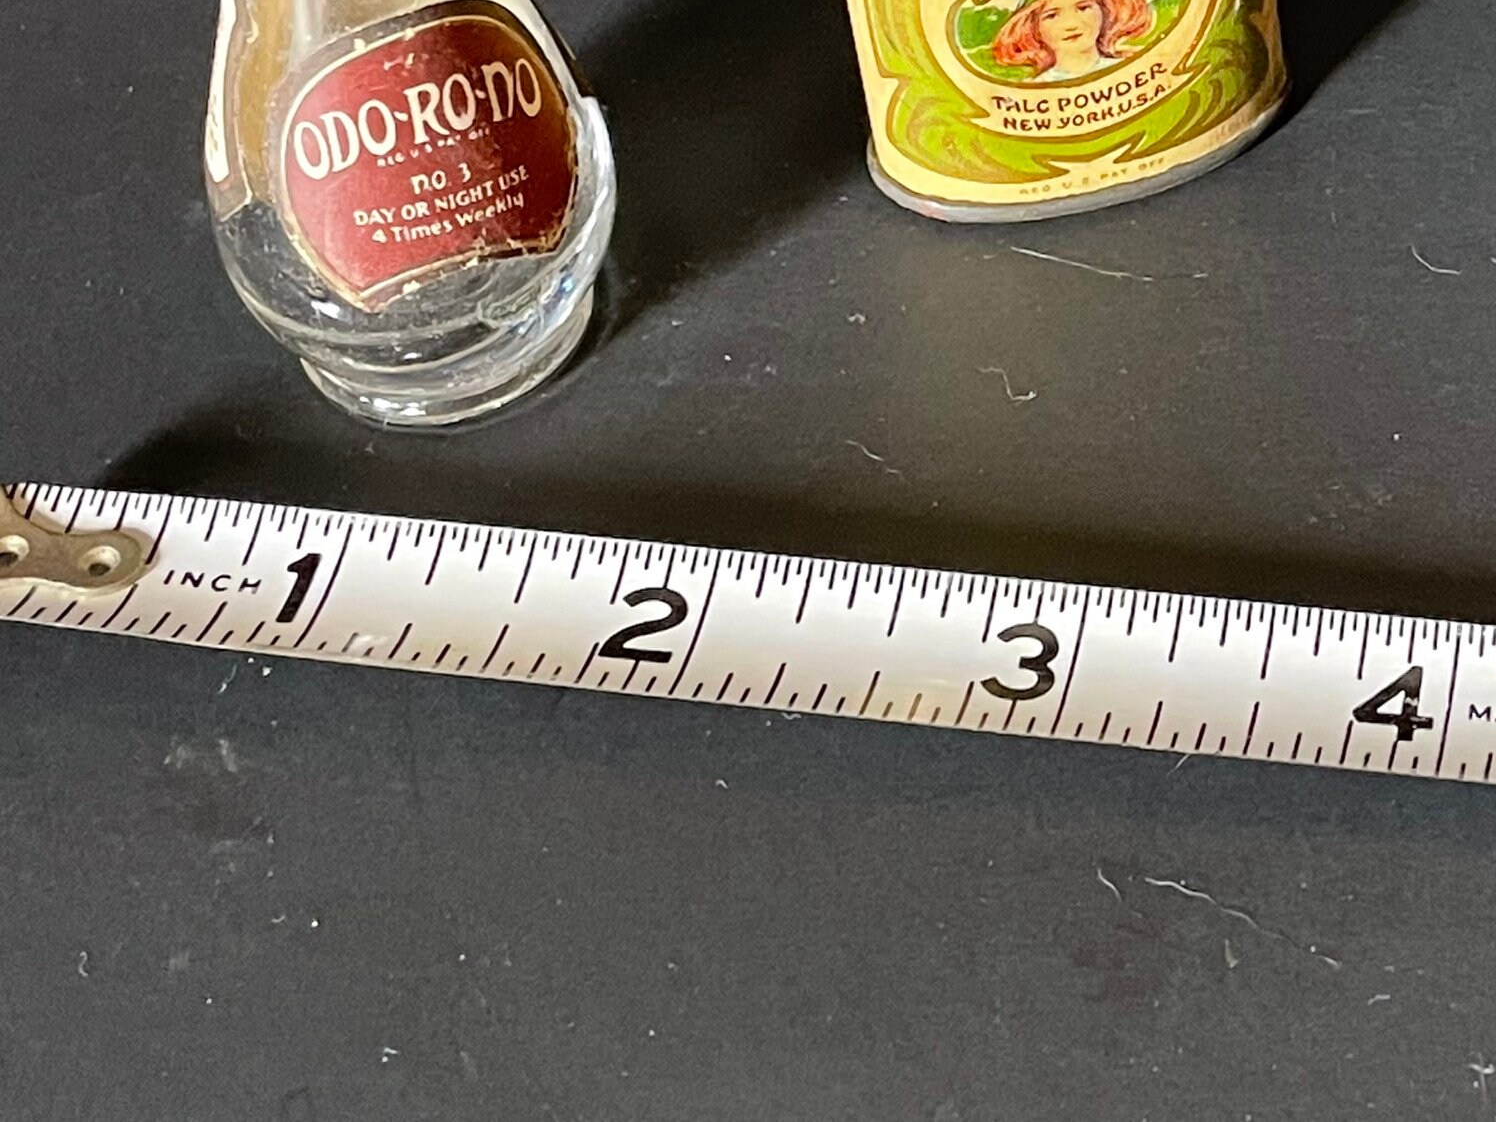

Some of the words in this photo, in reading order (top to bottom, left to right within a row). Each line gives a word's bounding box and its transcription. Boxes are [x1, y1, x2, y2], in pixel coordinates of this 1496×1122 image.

[991, 95, 1049, 114] TALC
[1058, 63, 1167, 112] POWDER
[1003, 117, 1050, 130] NEW
[353, 207, 395, 226] DAY
[401, 201, 430, 221] OR
[434, 181, 493, 213] NIGHT
[498, 164, 529, 190] USE
[458, 162, 471, 183] 3
[372, 228, 387, 243] 4
[455, 192, 524, 226] Weekly
[164, 569, 262, 596] INCH
[276, 553, 322, 623] 1
[598, 587, 689, 664] 2
[980, 623, 1060, 702] 3
[1353, 666, 1434, 742] 4
